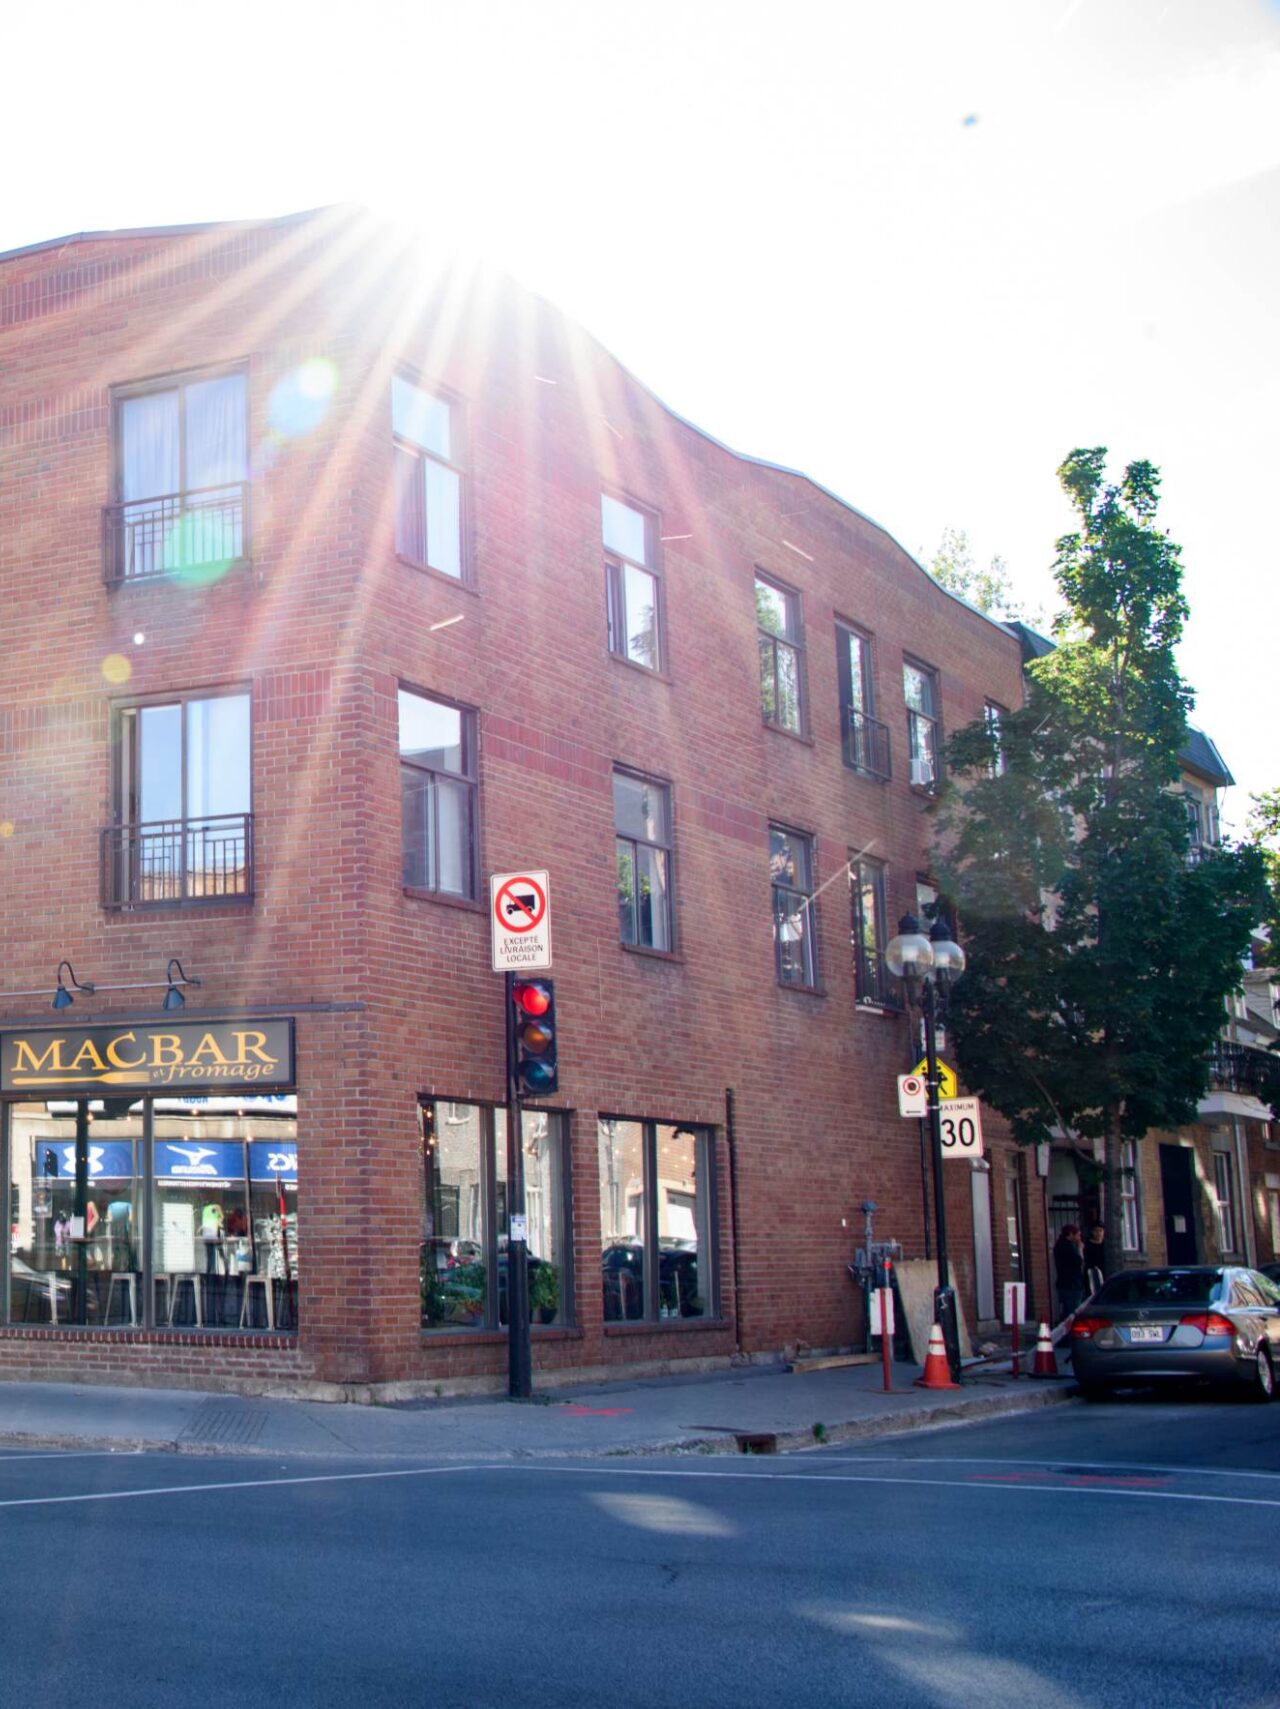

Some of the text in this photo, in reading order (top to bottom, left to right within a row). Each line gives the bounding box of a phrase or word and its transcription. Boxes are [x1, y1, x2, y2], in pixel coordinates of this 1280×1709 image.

[500, 944, 544, 955] LIVRAISON
[506, 954, 536, 963] LOCALE
[10, 1031, 278, 1071] MACBAR
[153, 1062, 275, 1084] et fromage
[941, 1117, 975, 1147] 30
